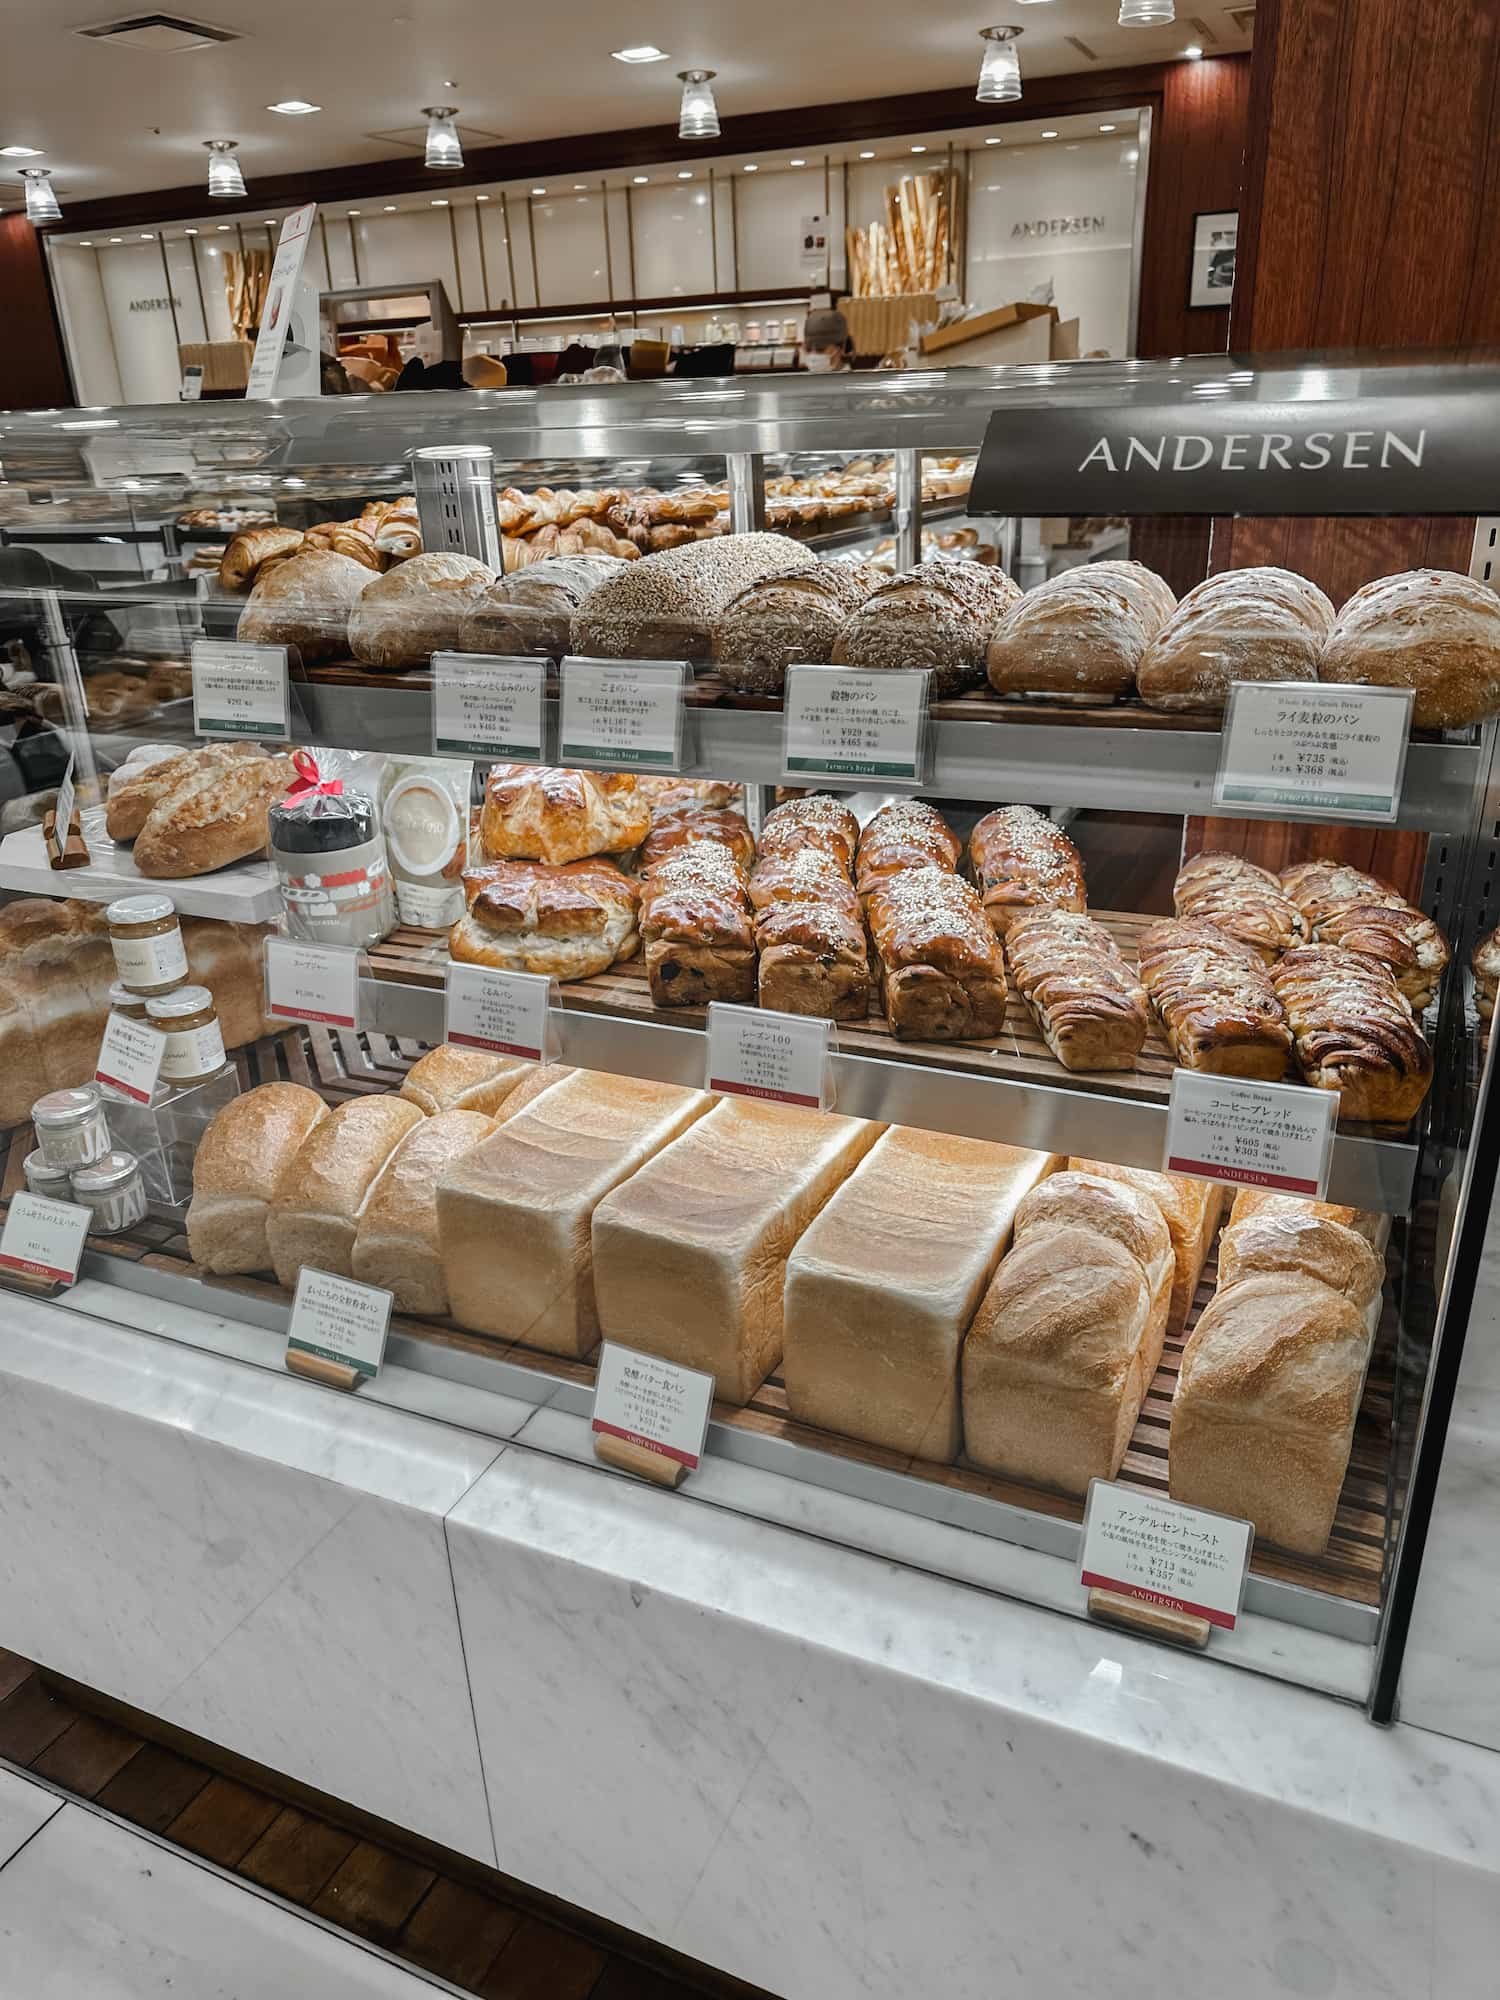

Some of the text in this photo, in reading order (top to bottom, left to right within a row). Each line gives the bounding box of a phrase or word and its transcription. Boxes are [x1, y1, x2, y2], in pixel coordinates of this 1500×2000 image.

[1009, 216, 1105, 240] ANDERSEN
[129, 297, 182, 312] ANDERSN
[1078, 429, 1427, 472] ANDERSEN
[831, 690, 878, 702] 穀物のパン
[1277, 711, 1360, 725] ライ麦粒のパン
[841, 727, 862, 736] ¥929
[840, 738, 862, 746] ¥465
[1298, 753, 1326, 764] ¥735
[1296, 764, 1324, 775] ¥368
[742, 1030, 791, 1045] レーズン100
[1230, 1090, 1251, 1099] Coffee
[1209, 1099, 1292, 1120] コーヒーブレッド
[1235, 1136, 1260, 1148] ¥605
[1234, 1146, 1258, 1157] ¥303
[1216, 1168, 1268, 1184] ANDERSEN
[623, 1366, 687, 1394] 発酵バター食パン
[1117, 1509, 1220, 1546] アンデルセントースト
[1150, 1556, 1175, 1571] ¥713
[1148, 1566, 1174, 1581] ¥357
[1130, 1589, 1184, 1611] ANDERSEN
